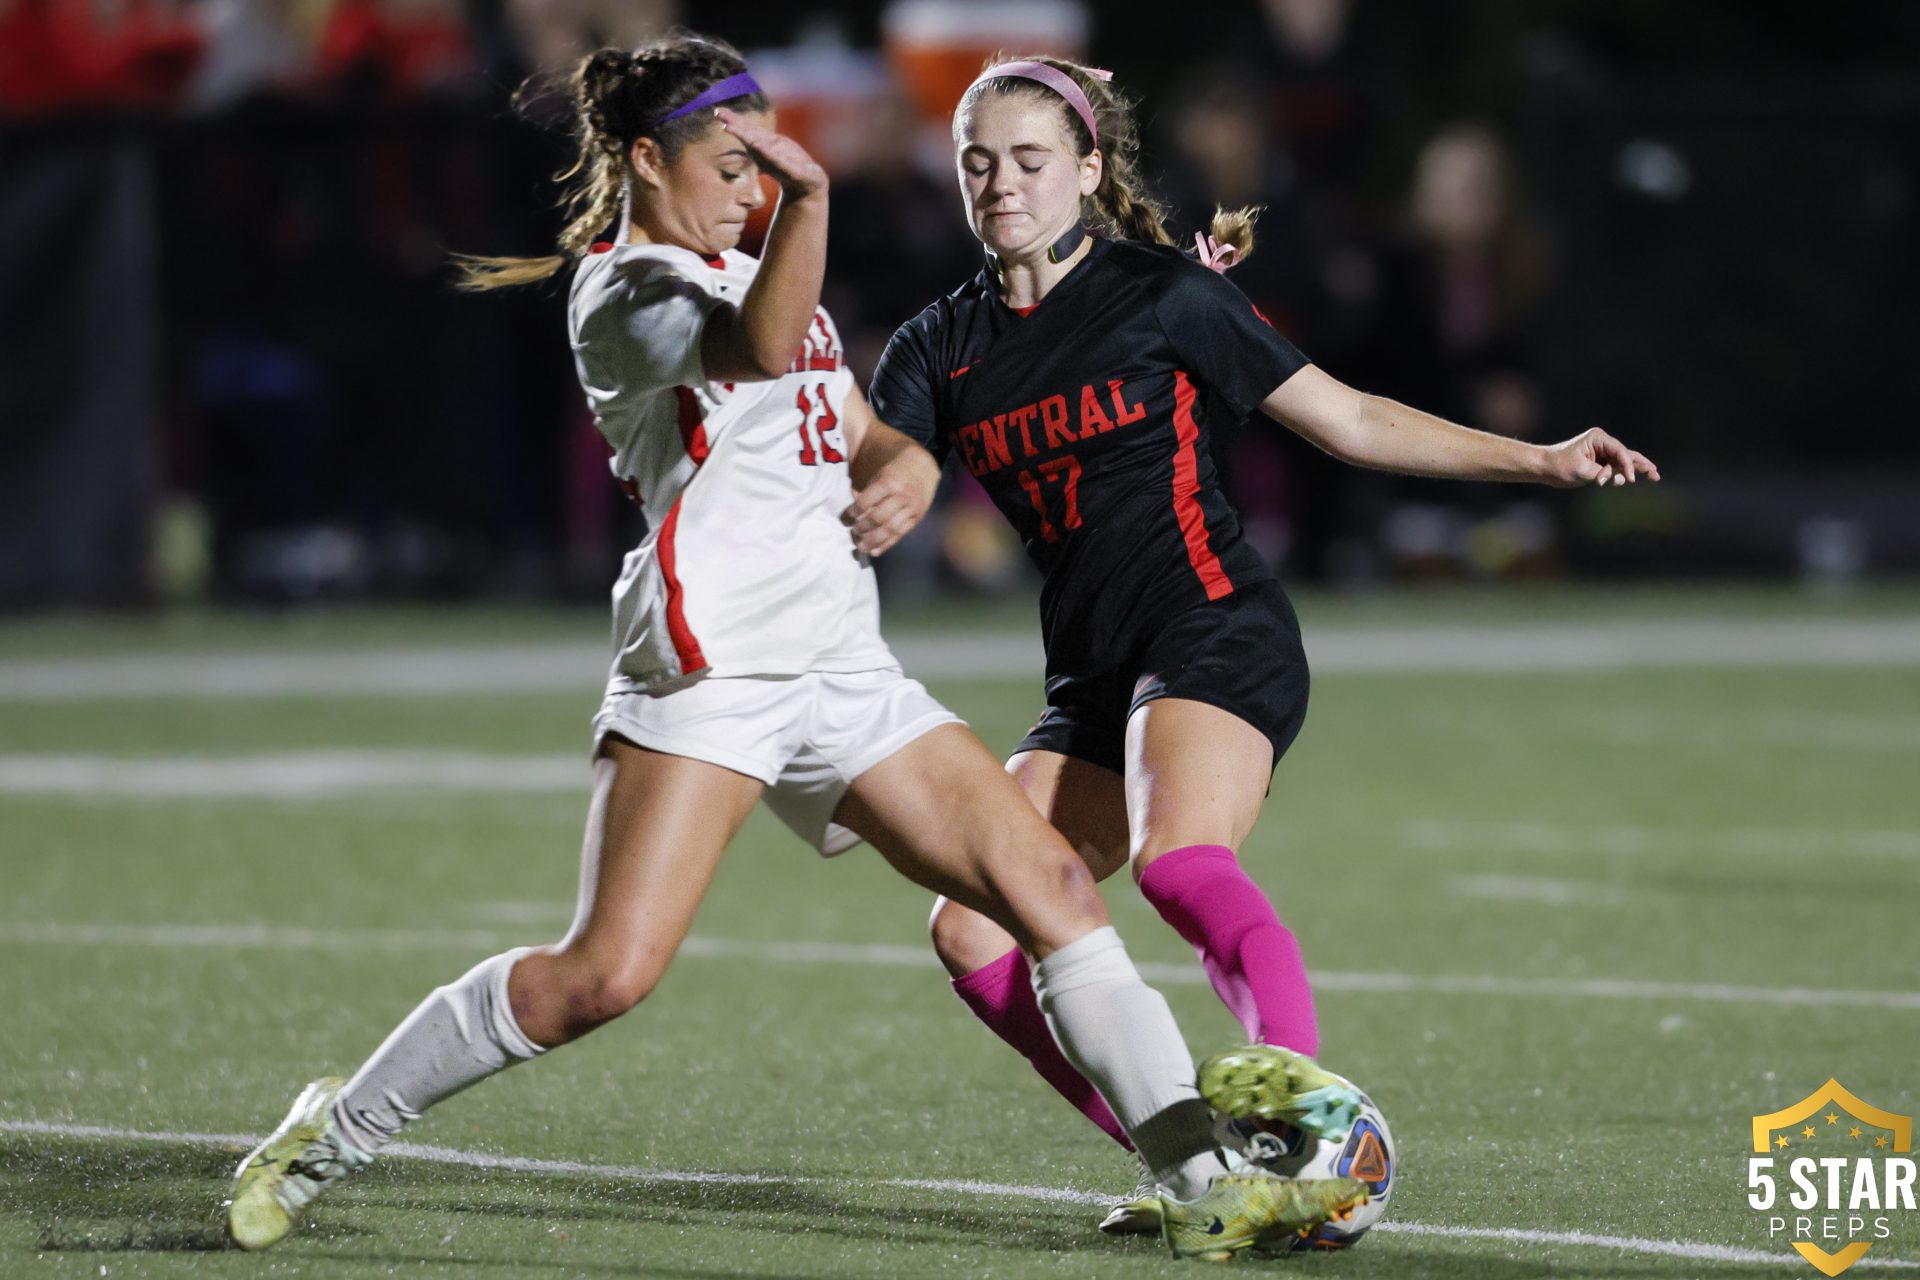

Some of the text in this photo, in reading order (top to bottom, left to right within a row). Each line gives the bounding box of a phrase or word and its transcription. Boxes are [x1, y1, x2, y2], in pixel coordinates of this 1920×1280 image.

[796, 383, 847, 466] 12
[951, 379, 1147, 477] ENTRAL
[1018, 454, 1083, 543] 17
